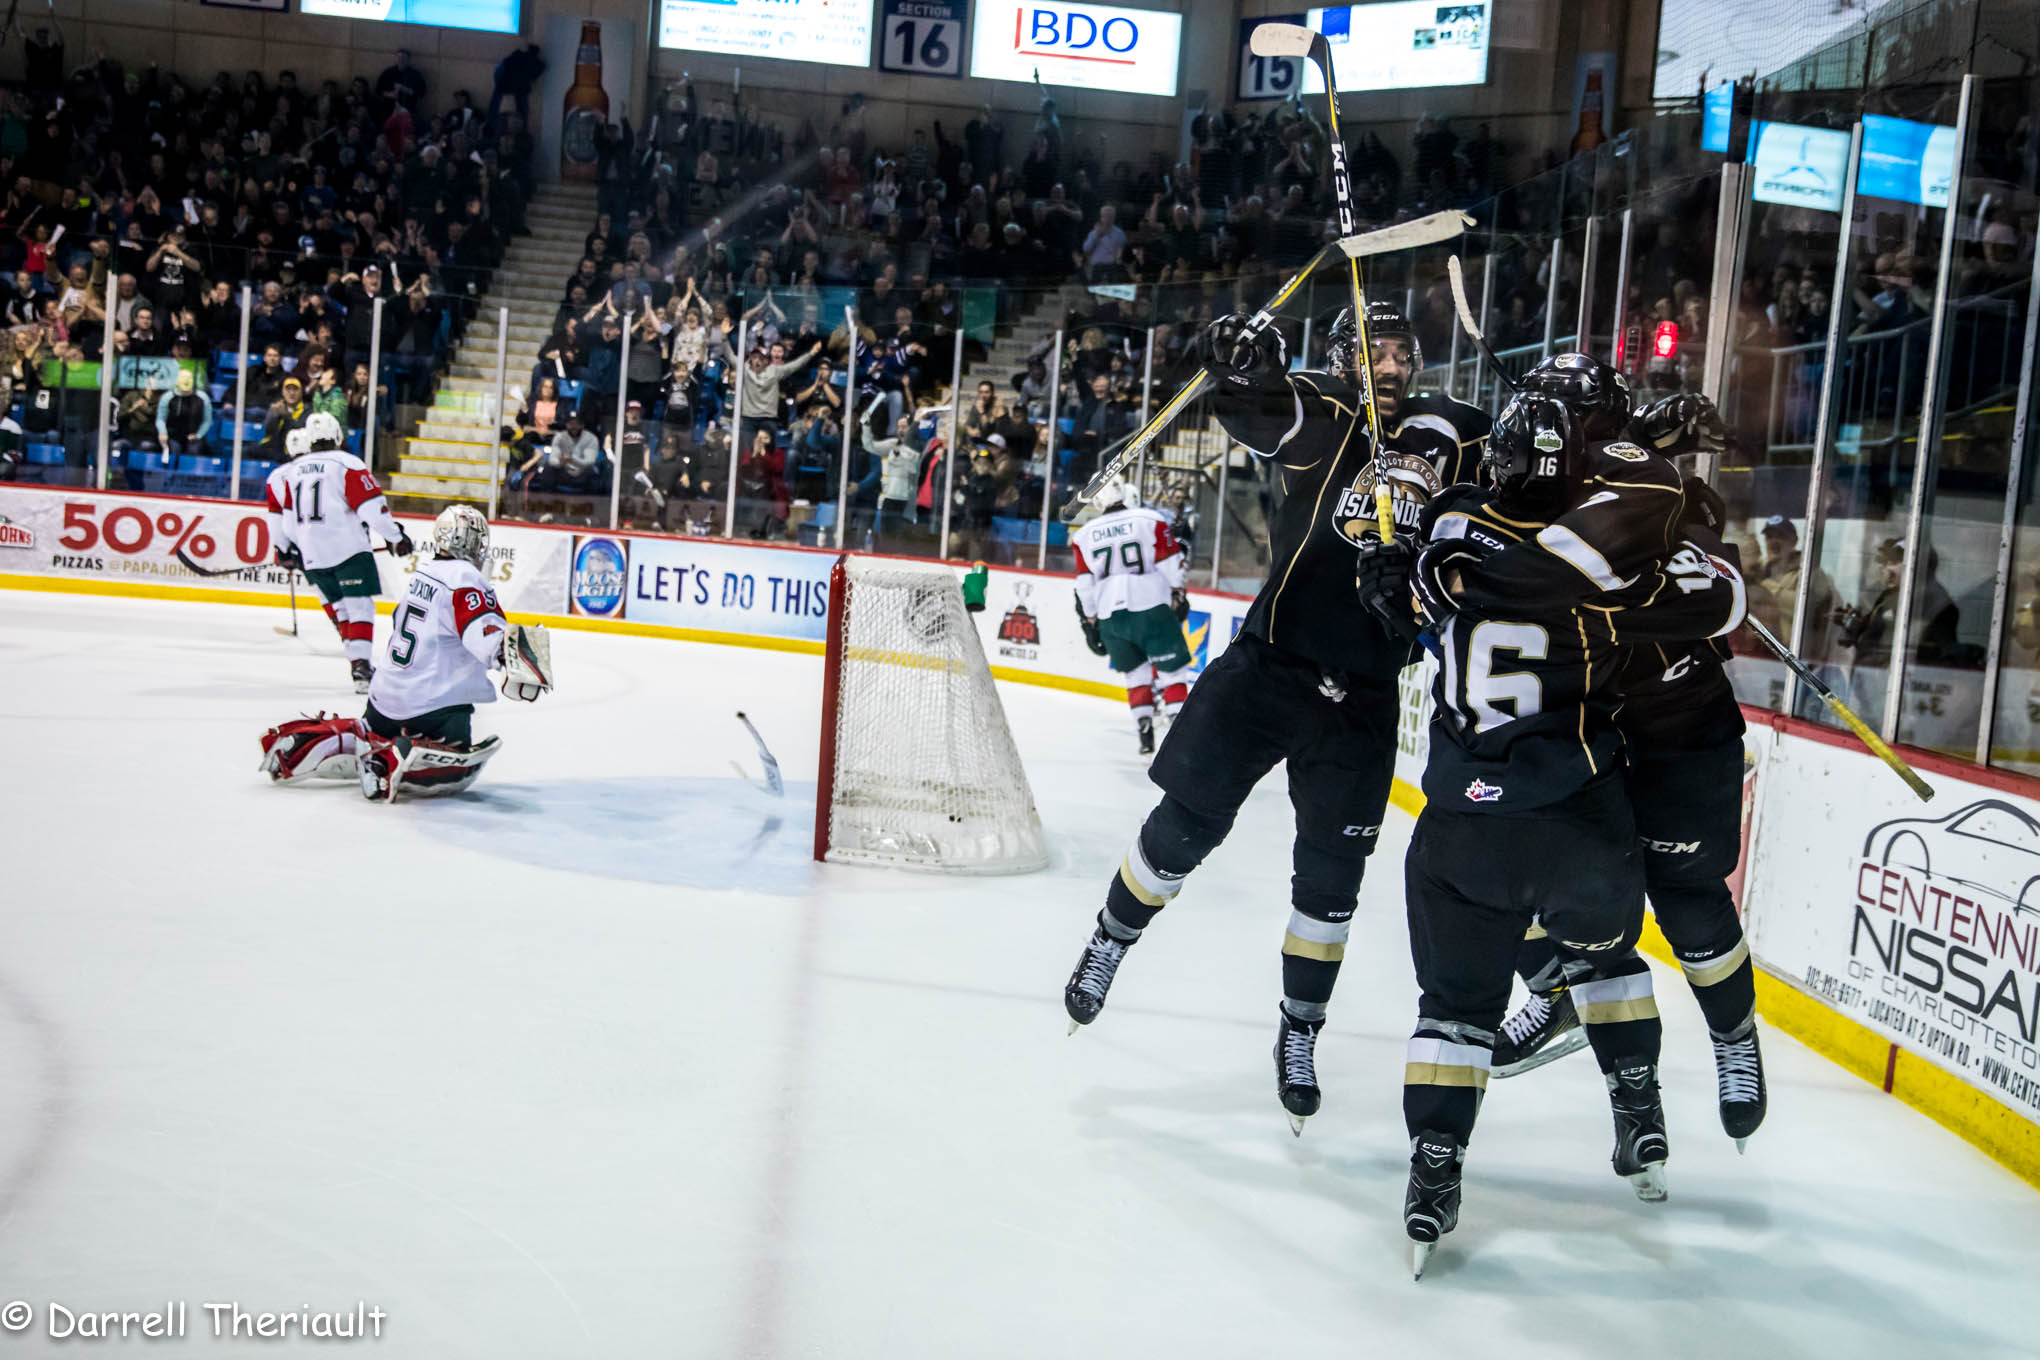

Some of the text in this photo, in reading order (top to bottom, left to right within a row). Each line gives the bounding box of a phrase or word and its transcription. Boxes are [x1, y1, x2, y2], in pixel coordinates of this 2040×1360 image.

[897, 3, 952, 17] SECTION
[1031, 9, 1139, 53] BDO
[894, 20, 950, 68] 16
[1248, 54, 1294, 93] 15
[1330, 143, 1353, 236] CCM
[1537, 456, 1558, 477] 16
[294, 480, 323, 524] 11
[0, 525, 32, 545] OHNS
[58, 502, 216, 559] 50%
[52, 555, 104, 571] PIZZAS
[1092, 541, 1145, 584] 79
[637, 563, 828, 618] LET'S DO THIS
[1004, 620, 1035, 640] 100
[421, 752, 468, 766] CCM
[1850, 904, 2040, 1045] NISSA
[1848, 960, 2040, 1070] OF CHARLOTTETO
[1620, 1064, 1649, 1076] CCM
[1868, 997, 1907, 1032] LOCATED
[1906, 1016, 1919, 1039] AT
[1918, 1022, 1927, 1044] 2
[1926, 1026, 1957, 1059] UPTON
[1982, 1055, 2040, 1110] WWW.CENTE
[1422, 1142, 1452, 1154] CCM
